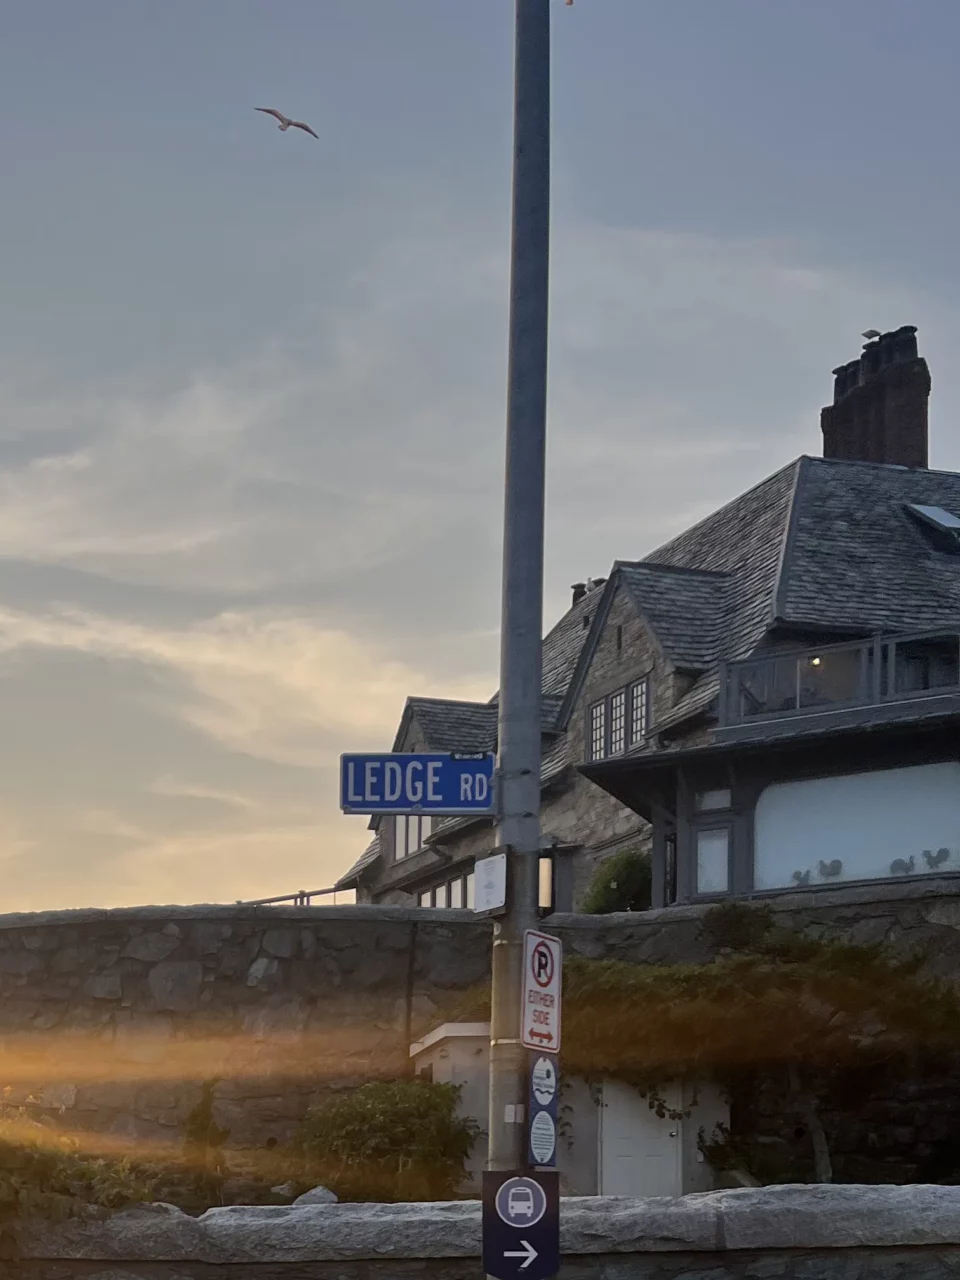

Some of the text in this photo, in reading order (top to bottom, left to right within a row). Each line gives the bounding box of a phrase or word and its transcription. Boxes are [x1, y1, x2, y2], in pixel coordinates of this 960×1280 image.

[347, 760, 488, 802] LEDGE RD
[528, 989, 555, 1008] EITHER
[532, 1008, 551, 1026] SIDE
